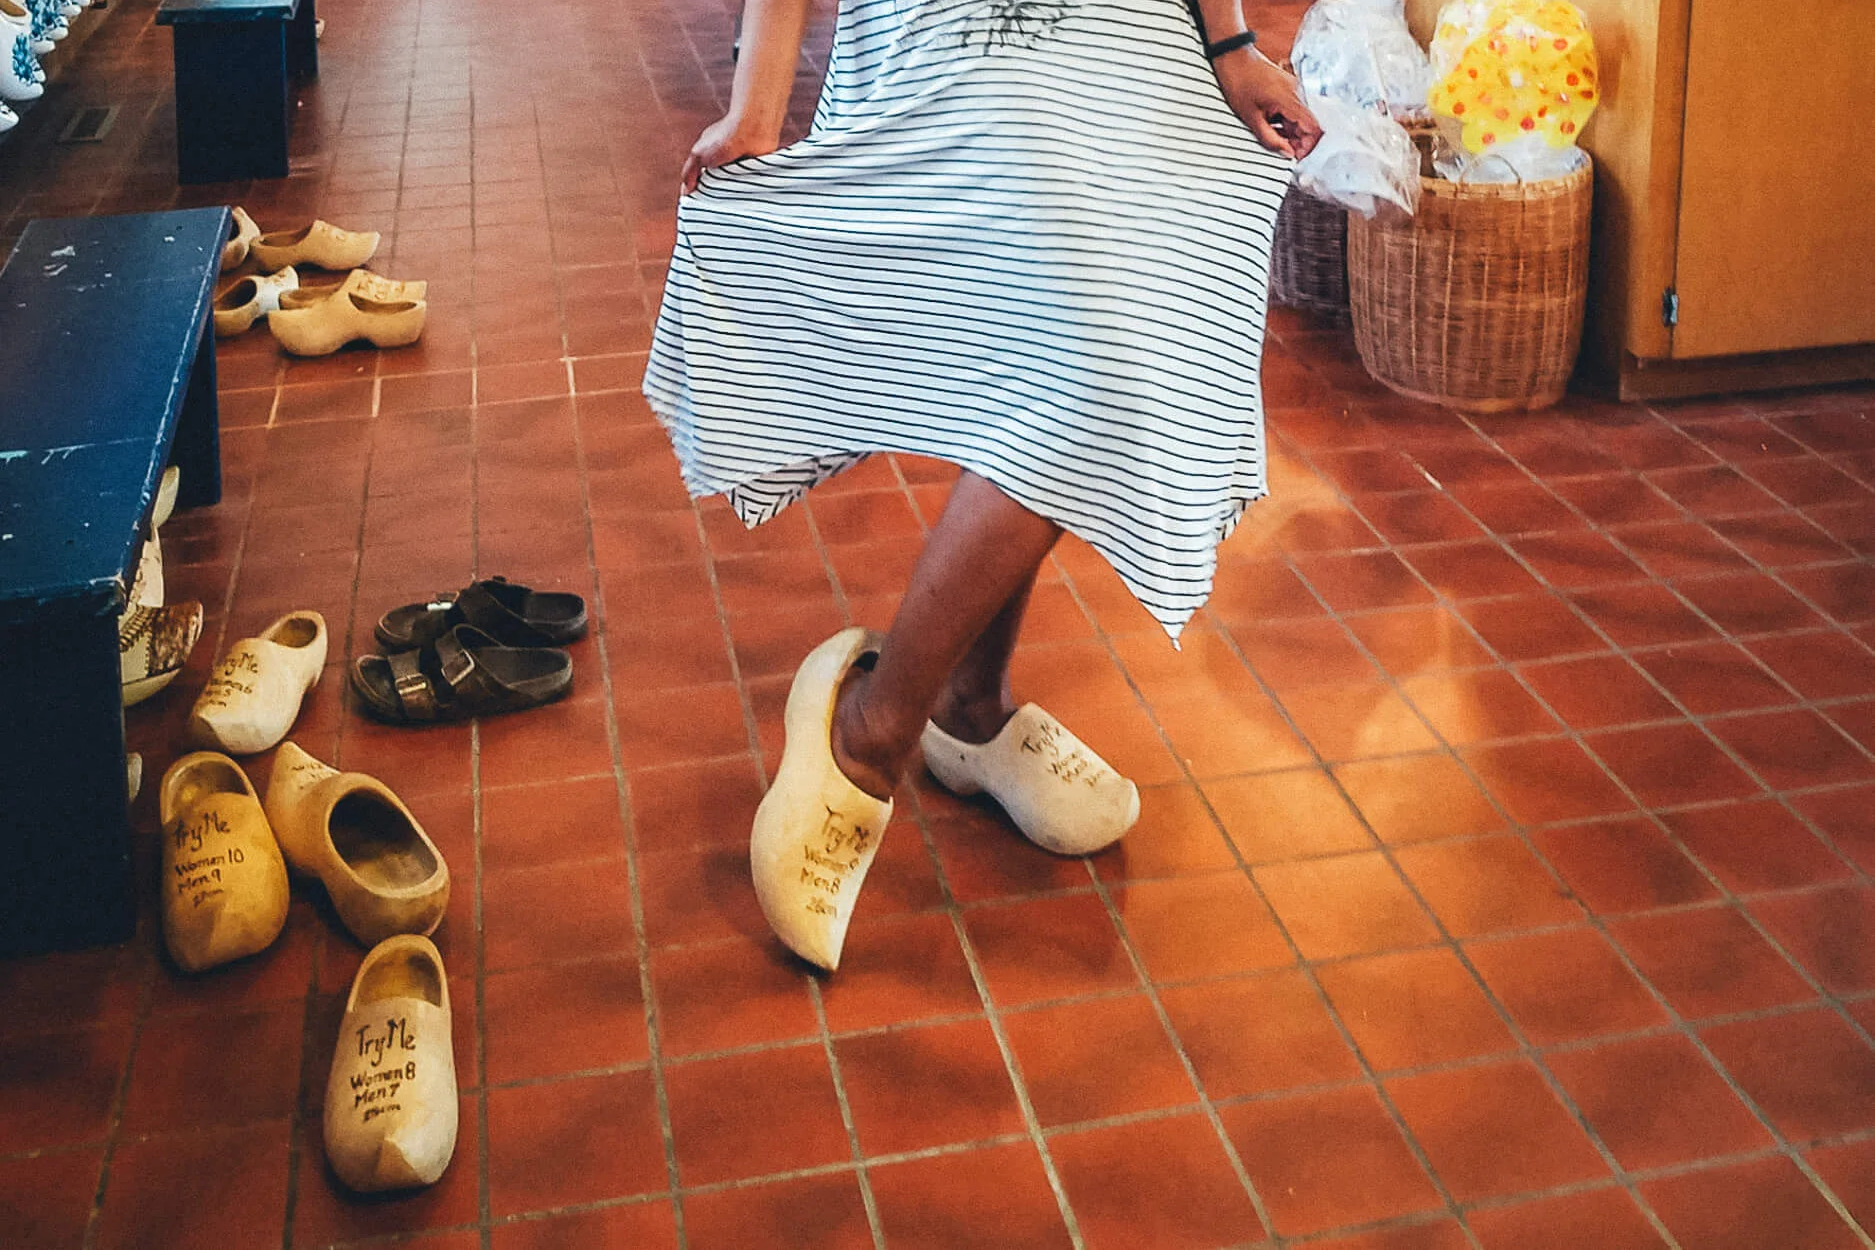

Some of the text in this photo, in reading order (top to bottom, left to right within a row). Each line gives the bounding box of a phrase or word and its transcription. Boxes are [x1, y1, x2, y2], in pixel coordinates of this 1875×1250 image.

[238, 652, 258, 673] Me
[203, 811, 231, 835] Me
[822, 804, 846, 855] Try
[175, 847, 245, 876] Women 10
[178, 868, 222, 895] Men 9
[801, 867, 830, 892] Men
[356, 1017, 417, 1067] Try Me
[350, 1060, 417, 1090] Women 8
[354, 1082, 401, 1108] Men 7
